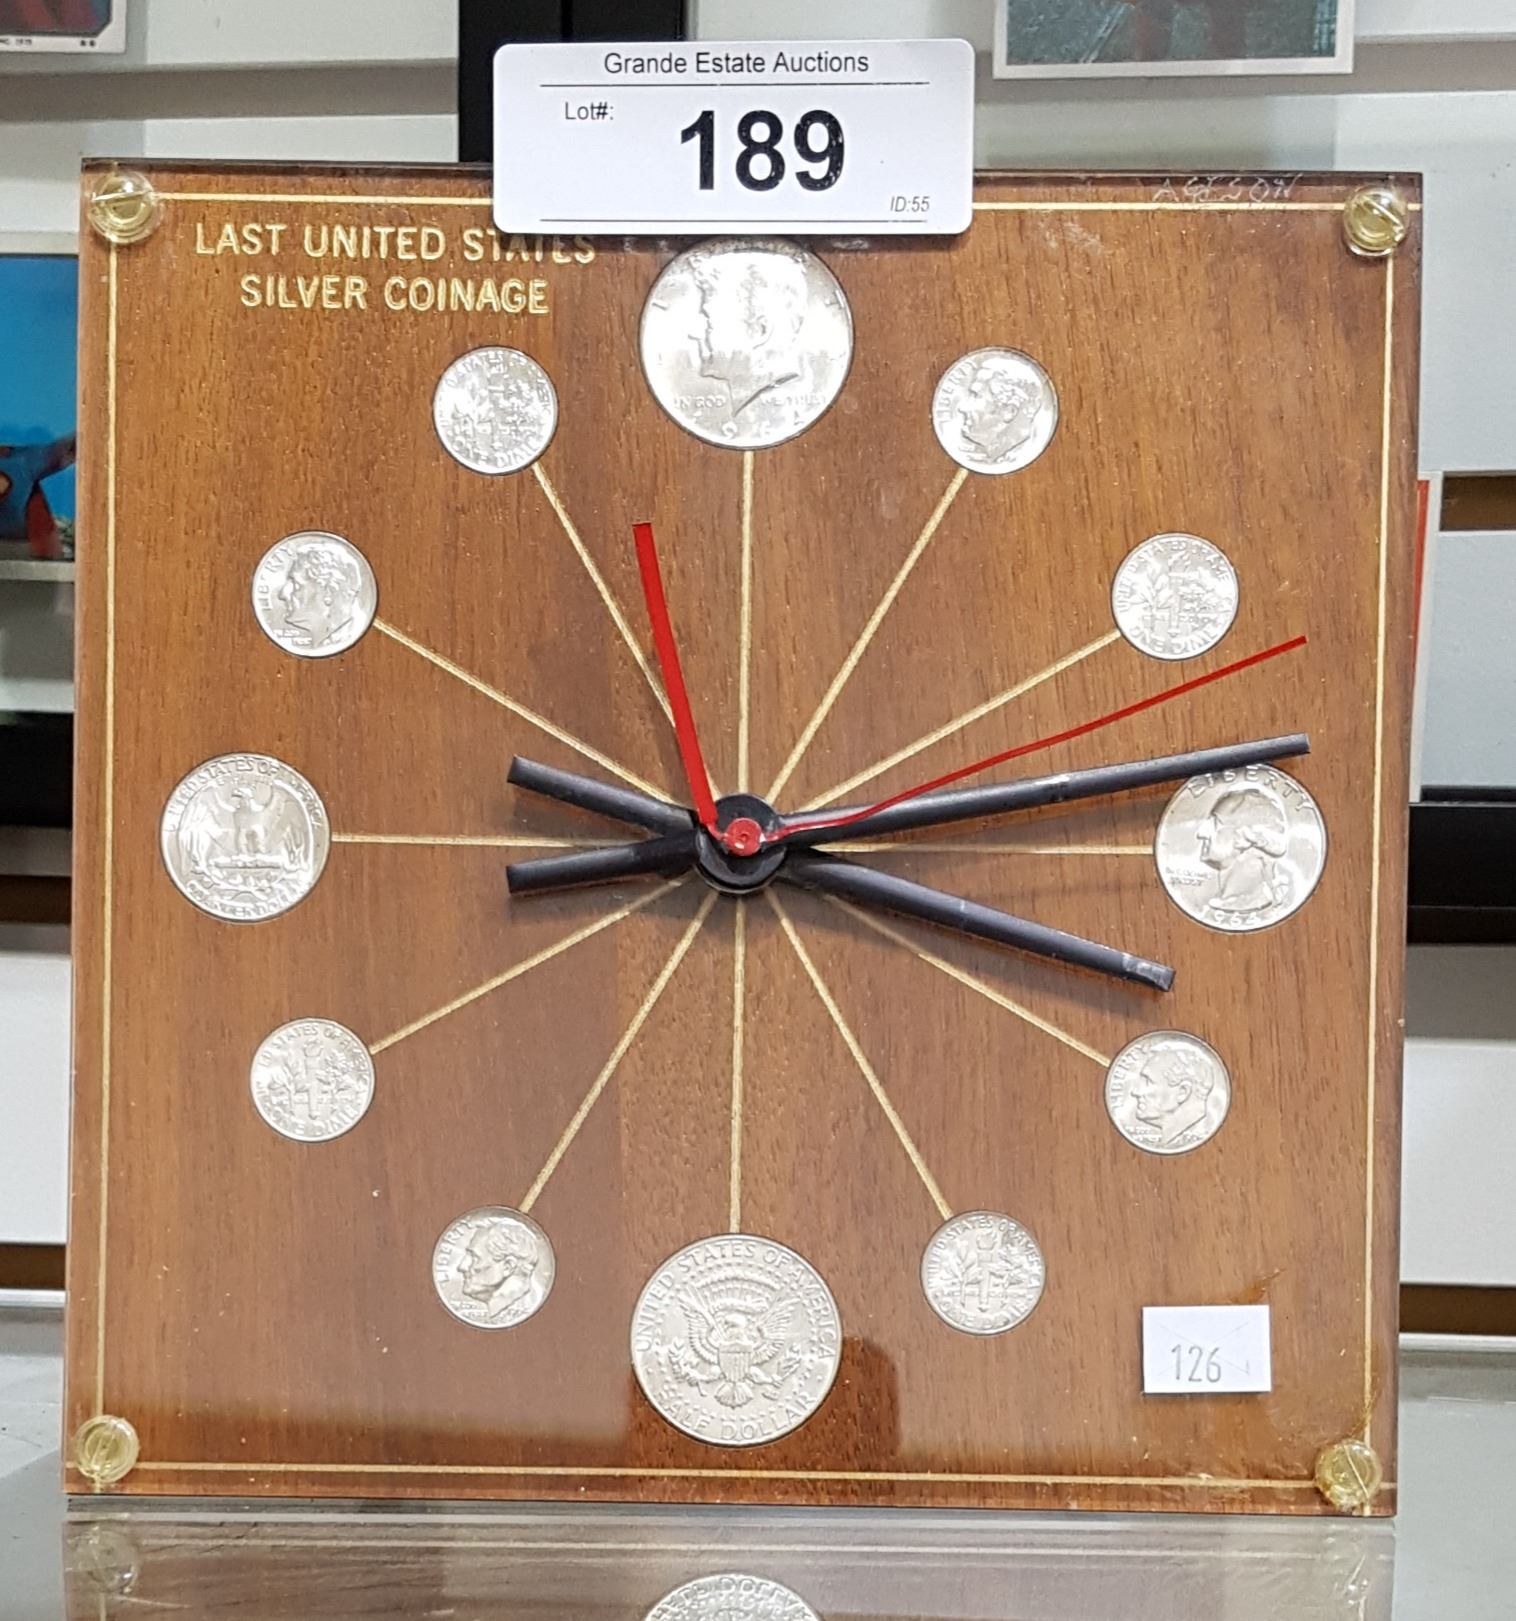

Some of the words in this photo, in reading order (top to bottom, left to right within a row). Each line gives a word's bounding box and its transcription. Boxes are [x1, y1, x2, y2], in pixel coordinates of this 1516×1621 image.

[604, 53, 687, 75] Grande
[695, 52, 766, 74] Estate
[773, 51, 870, 73] Auctions
[564, 101, 614, 121] Lot#:
[680, 109, 845, 192] 189
[889, 196, 931, 213] ID:55
[195, 222, 287, 256] LAST
[303, 224, 447, 261] UNITED
[463, 227, 596, 264] STATES
[240, 274, 368, 310] SILVER
[384, 275, 550, 315] COINAGE
[1187, 765, 1314, 812] LIBERTY
[638, 1274, 675, 1352] UNITED
[678, 1242, 756, 1273] STATES
[762, 1246, 787, 1268] OF
[788, 1268, 836, 1359] AMERICA
[1171, 1343, 1222, 1384] 126
[720, 1391, 816, 1440] DOLLAR
